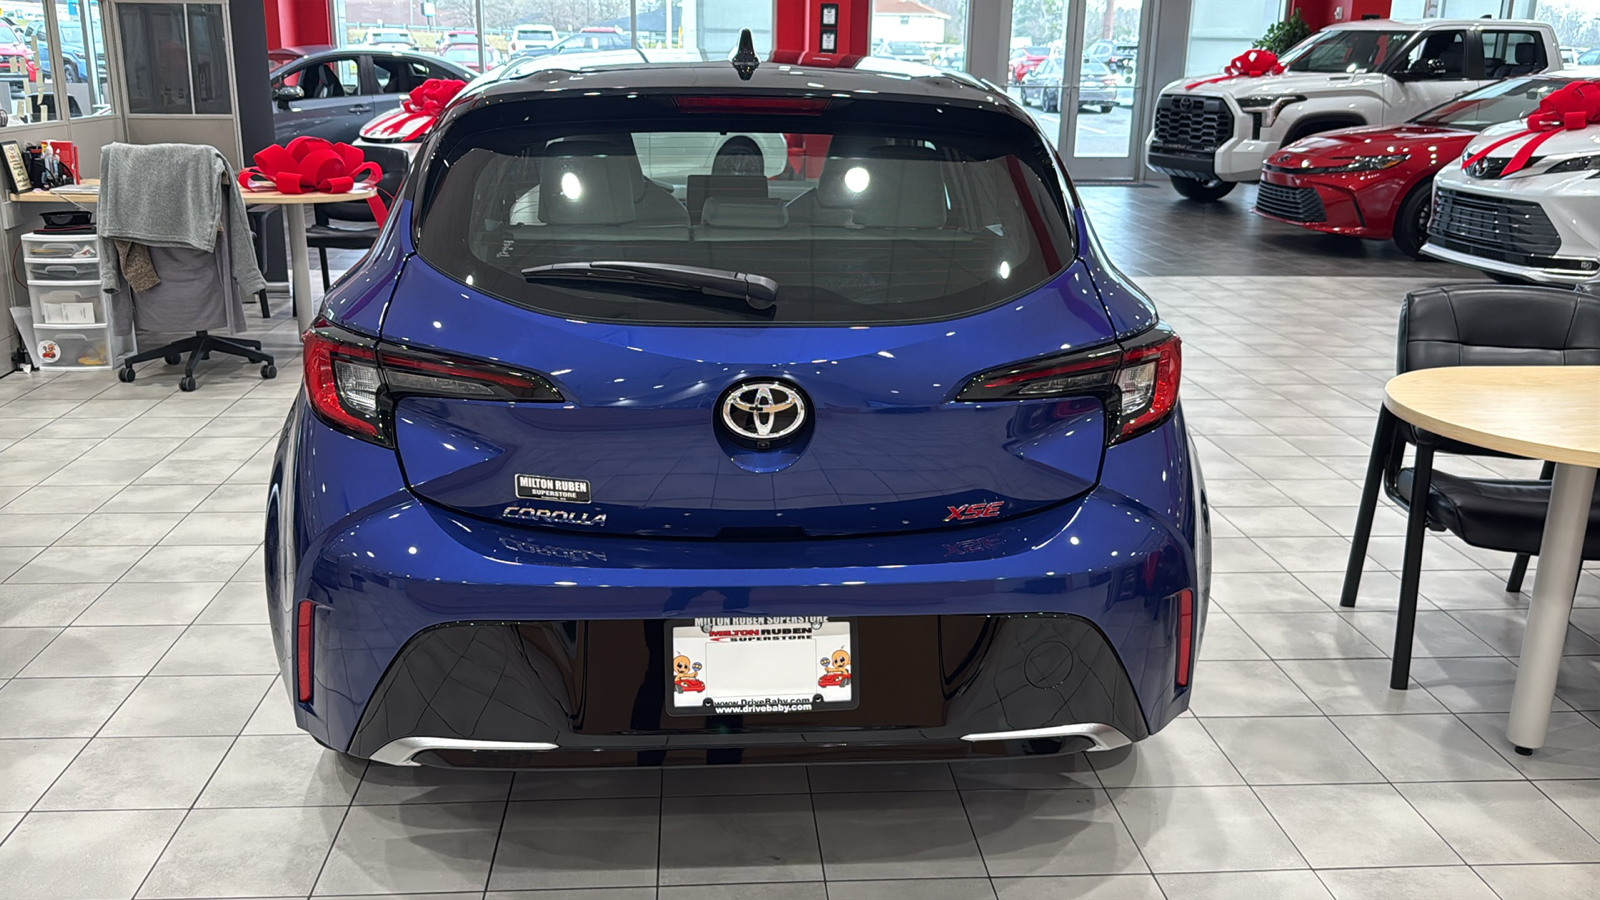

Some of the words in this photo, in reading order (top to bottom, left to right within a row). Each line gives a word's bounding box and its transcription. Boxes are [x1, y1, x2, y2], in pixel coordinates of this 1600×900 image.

[519, 477, 554, 489] MILTON
[555, 481, 587, 492] RUBEN
[531, 489, 577, 498] SUPERSTORE
[503, 506, 607, 526] COROLLA
[942, 500, 1005, 522] XSE
[694, 617, 731, 627] MILTON
[732, 617, 765, 625] RUBEN
[715, 704, 812, 713] www.drivebaby.com
